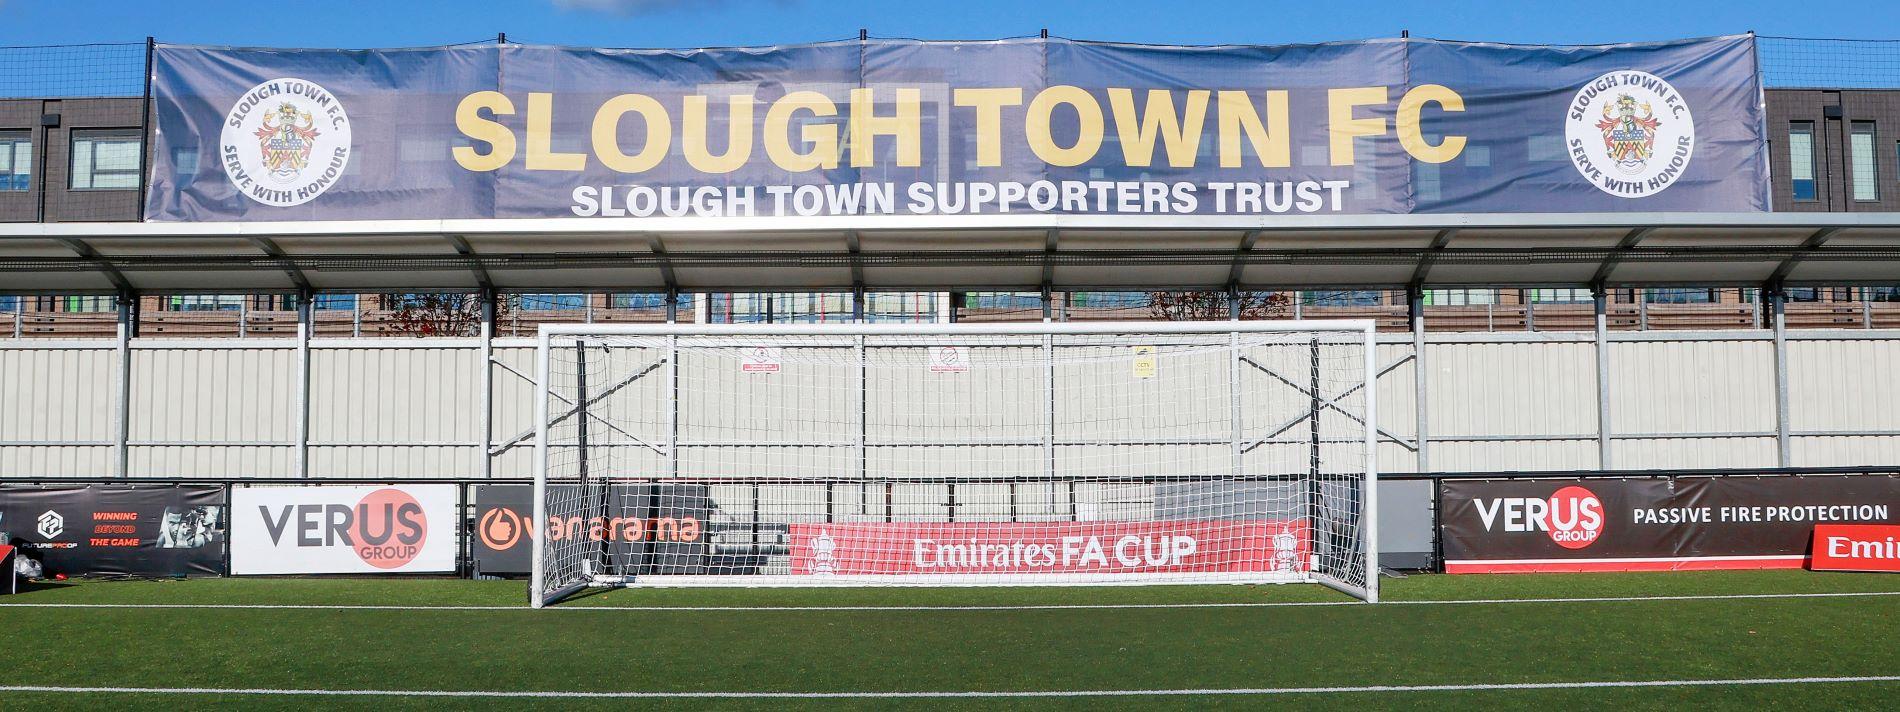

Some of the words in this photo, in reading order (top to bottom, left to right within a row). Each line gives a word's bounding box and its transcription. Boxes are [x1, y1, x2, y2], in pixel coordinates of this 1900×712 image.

[229, 82, 281, 128] SLOUGH
[284, 81, 331, 108] TOWN
[1571, 75, 1618, 121] SLOUGH
[1621, 73, 1668, 98] TOWN
[452, 87, 921, 173] SLOUGH
[953, 85, 1291, 168] TOWN
[1327, 84, 1467, 167] FC
[224, 145, 253, 189] SERVE
[252, 184, 293, 202] WITH
[296, 146, 347, 200] HONOUR
[1570, 138, 1602, 181] SERVE
[1604, 176, 1644, 194] WITH
[1647, 135, 1691, 190] HONOUR
[570, 184, 755, 217] SLOUGH
[766, 182, 895, 216] TOWN
[907, 180, 1199, 215] SUPPORTERS
[1208, 179, 1350, 213] TRUST
[93, 512, 138, 520] WINNING
[94, 525, 136, 534] BEYOND
[258, 502, 423, 548] VERUS
[1473, 496, 1601, 532] VERUS
[1633, 507, 1712, 524] PASSIVE
[1721, 505, 1762, 523] FIRE
[1766, 504, 1888, 522] PROTECTION
[90, 538, 109, 546] THE
[111, 538, 140, 546] GAME
[360, 545, 418, 561] GROUP
[913, 537, 1056, 569] Emirates
[1062, 535, 1107, 567] FA
[1115, 534, 1198, 567] CUP
[1553, 529, 1597, 542] GROUP
[1827, 536, 1900, 559] Emi
